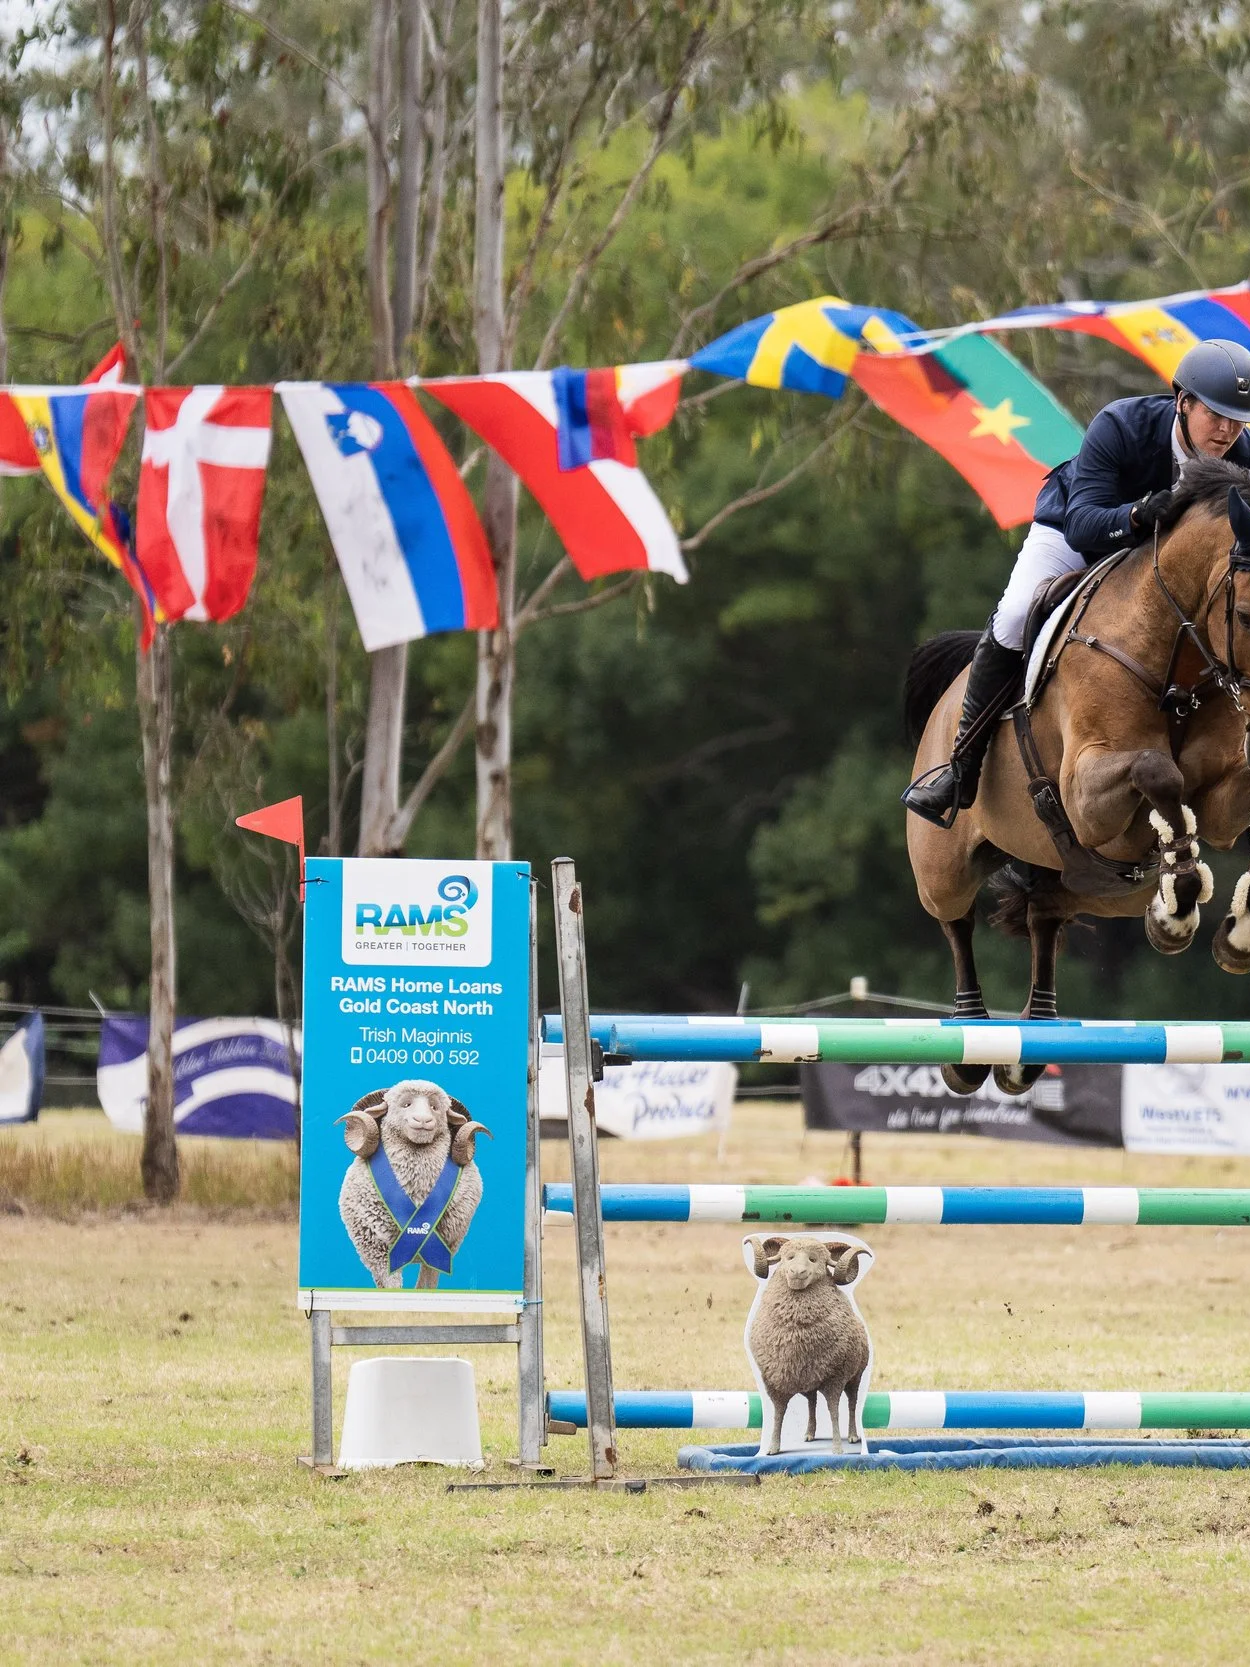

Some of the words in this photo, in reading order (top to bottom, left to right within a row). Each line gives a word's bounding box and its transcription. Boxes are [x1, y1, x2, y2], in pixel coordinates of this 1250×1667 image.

[356, 903, 469, 937] RAMS
[355, 942, 403, 950] GREATER
[412, 943, 466, 951] TOGETHER
[331, 976, 386, 993] RAMS
[391, 977, 444, 994] Home
[448, 978, 503, 995] Loans
[339, 998, 382, 1014] Gold
[386, 999, 439, 1015] Coast
[443, 1000, 493, 1016] North
[359, 1026, 397, 1043] Trish
[401, 1028, 473, 1047] Maginnis
[366, 1048, 408, 1064] 0409
[412, 1049, 444, 1065] 000
[448, 1050, 480, 1066] 592
[407, 1227, 429, 1235] RAMS
